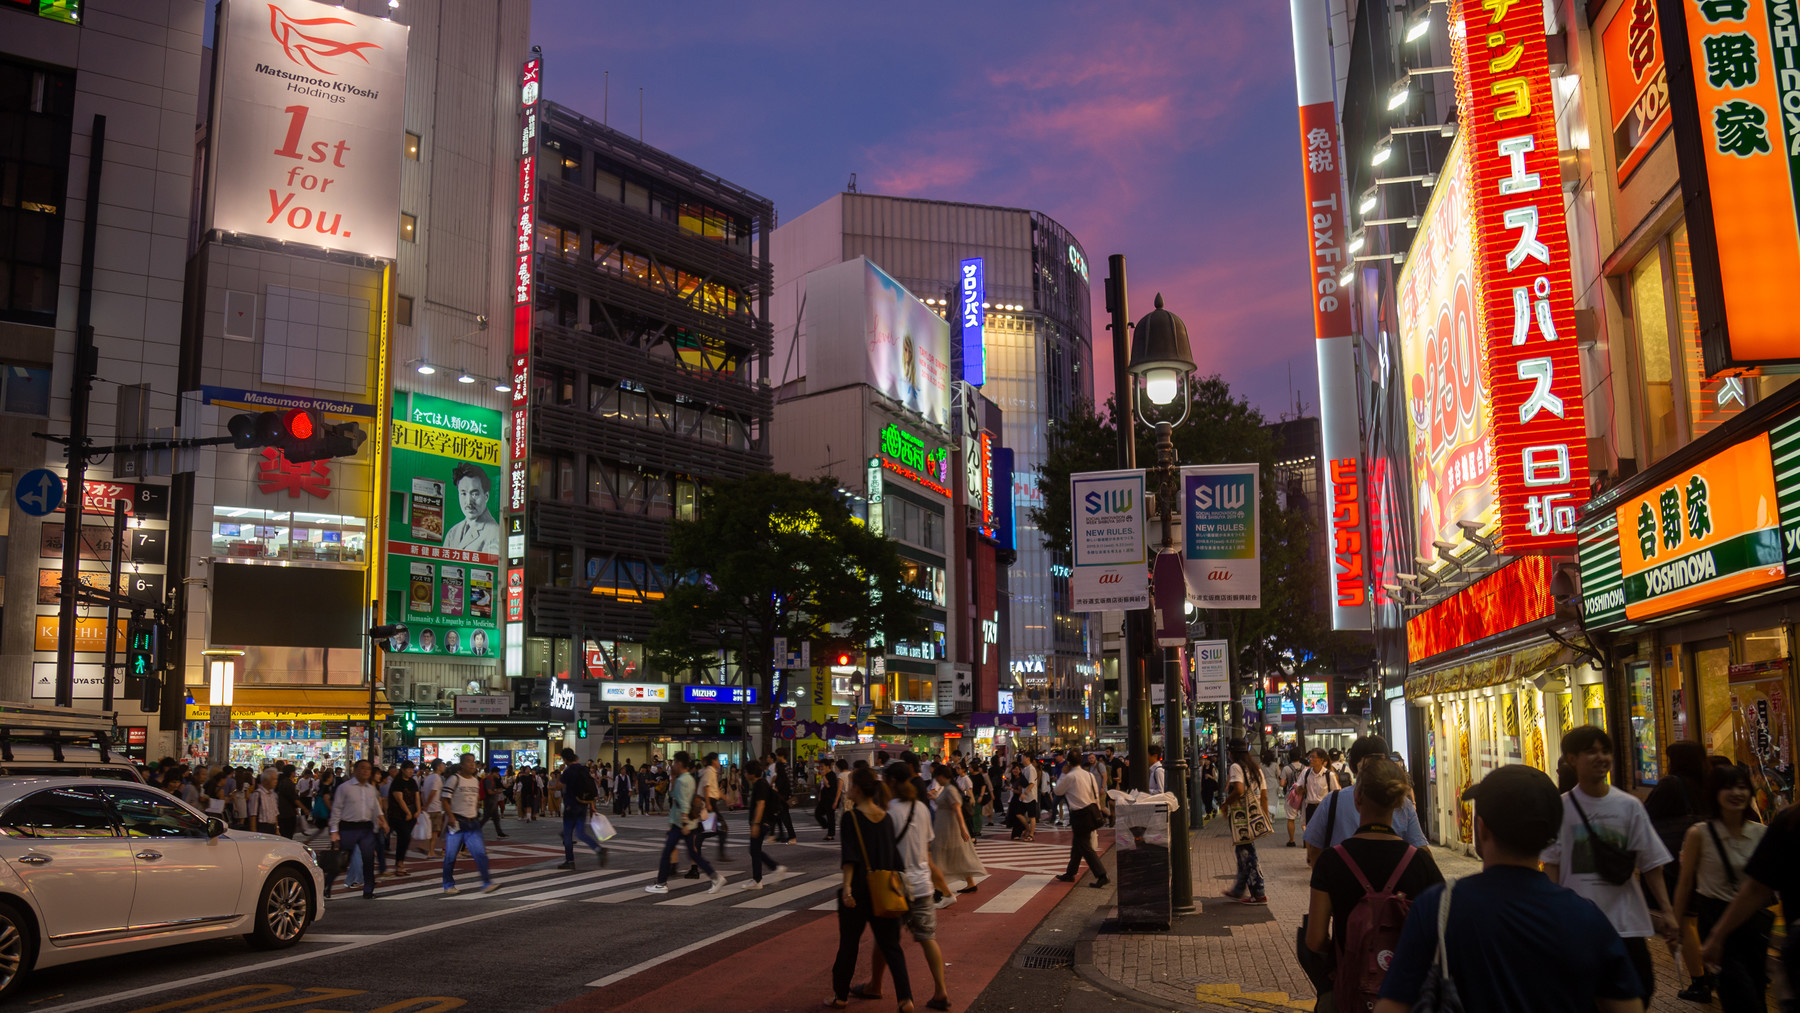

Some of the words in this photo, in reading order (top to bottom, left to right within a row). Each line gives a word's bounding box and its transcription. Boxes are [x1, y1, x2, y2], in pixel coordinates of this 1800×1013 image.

[255, 63, 331, 89] Matsumoto
[333, 81, 379, 100] KiYoshi
[287, 82, 346, 104] Holdings
[273, 105, 351, 168] 1st
[1307, 128, 1334, 173] 免税
[287, 167, 334, 193] for
[266, 189, 352, 238] You.
[963, 264, 979, 328] サロンパス
[1425, 270, 1490, 465] 230
[244, 392, 310, 409] Matsumoto
[312, 400, 354, 414] KiYoshi
[413, 408, 488, 435] 全ては人類の為に
[391, 423, 499, 463] 野口医学研究所
[1085, 488, 1132, 515] SIW
[1195, 483, 1245, 510] SIW
[1195, 524, 1215, 532] NEW
[1217, 523, 1246, 532] RULES.
[1638, 474, 1713, 561] 吉野家
[1086, 529, 1104, 537] NEW
[1106, 528, 1135, 536] RULES.
[1329, 457, 1364, 607] ビックカメラ
[410, 545, 480, 562] 新健康活力製品
[1099, 573, 1123, 584] au
[1207, 569, 1233, 581] au
[1645, 550, 1717, 597] YOSHINOYA
[1584, 588, 1625, 616] YOSHINOYA
[407, 614, 434, 624] Humanity
[441, 617, 464, 626] Empathy
[472, 620, 495, 628] Medicine
[1201, 648, 1222, 660] SIW
[692, 688, 717, 697] MIZUHO
